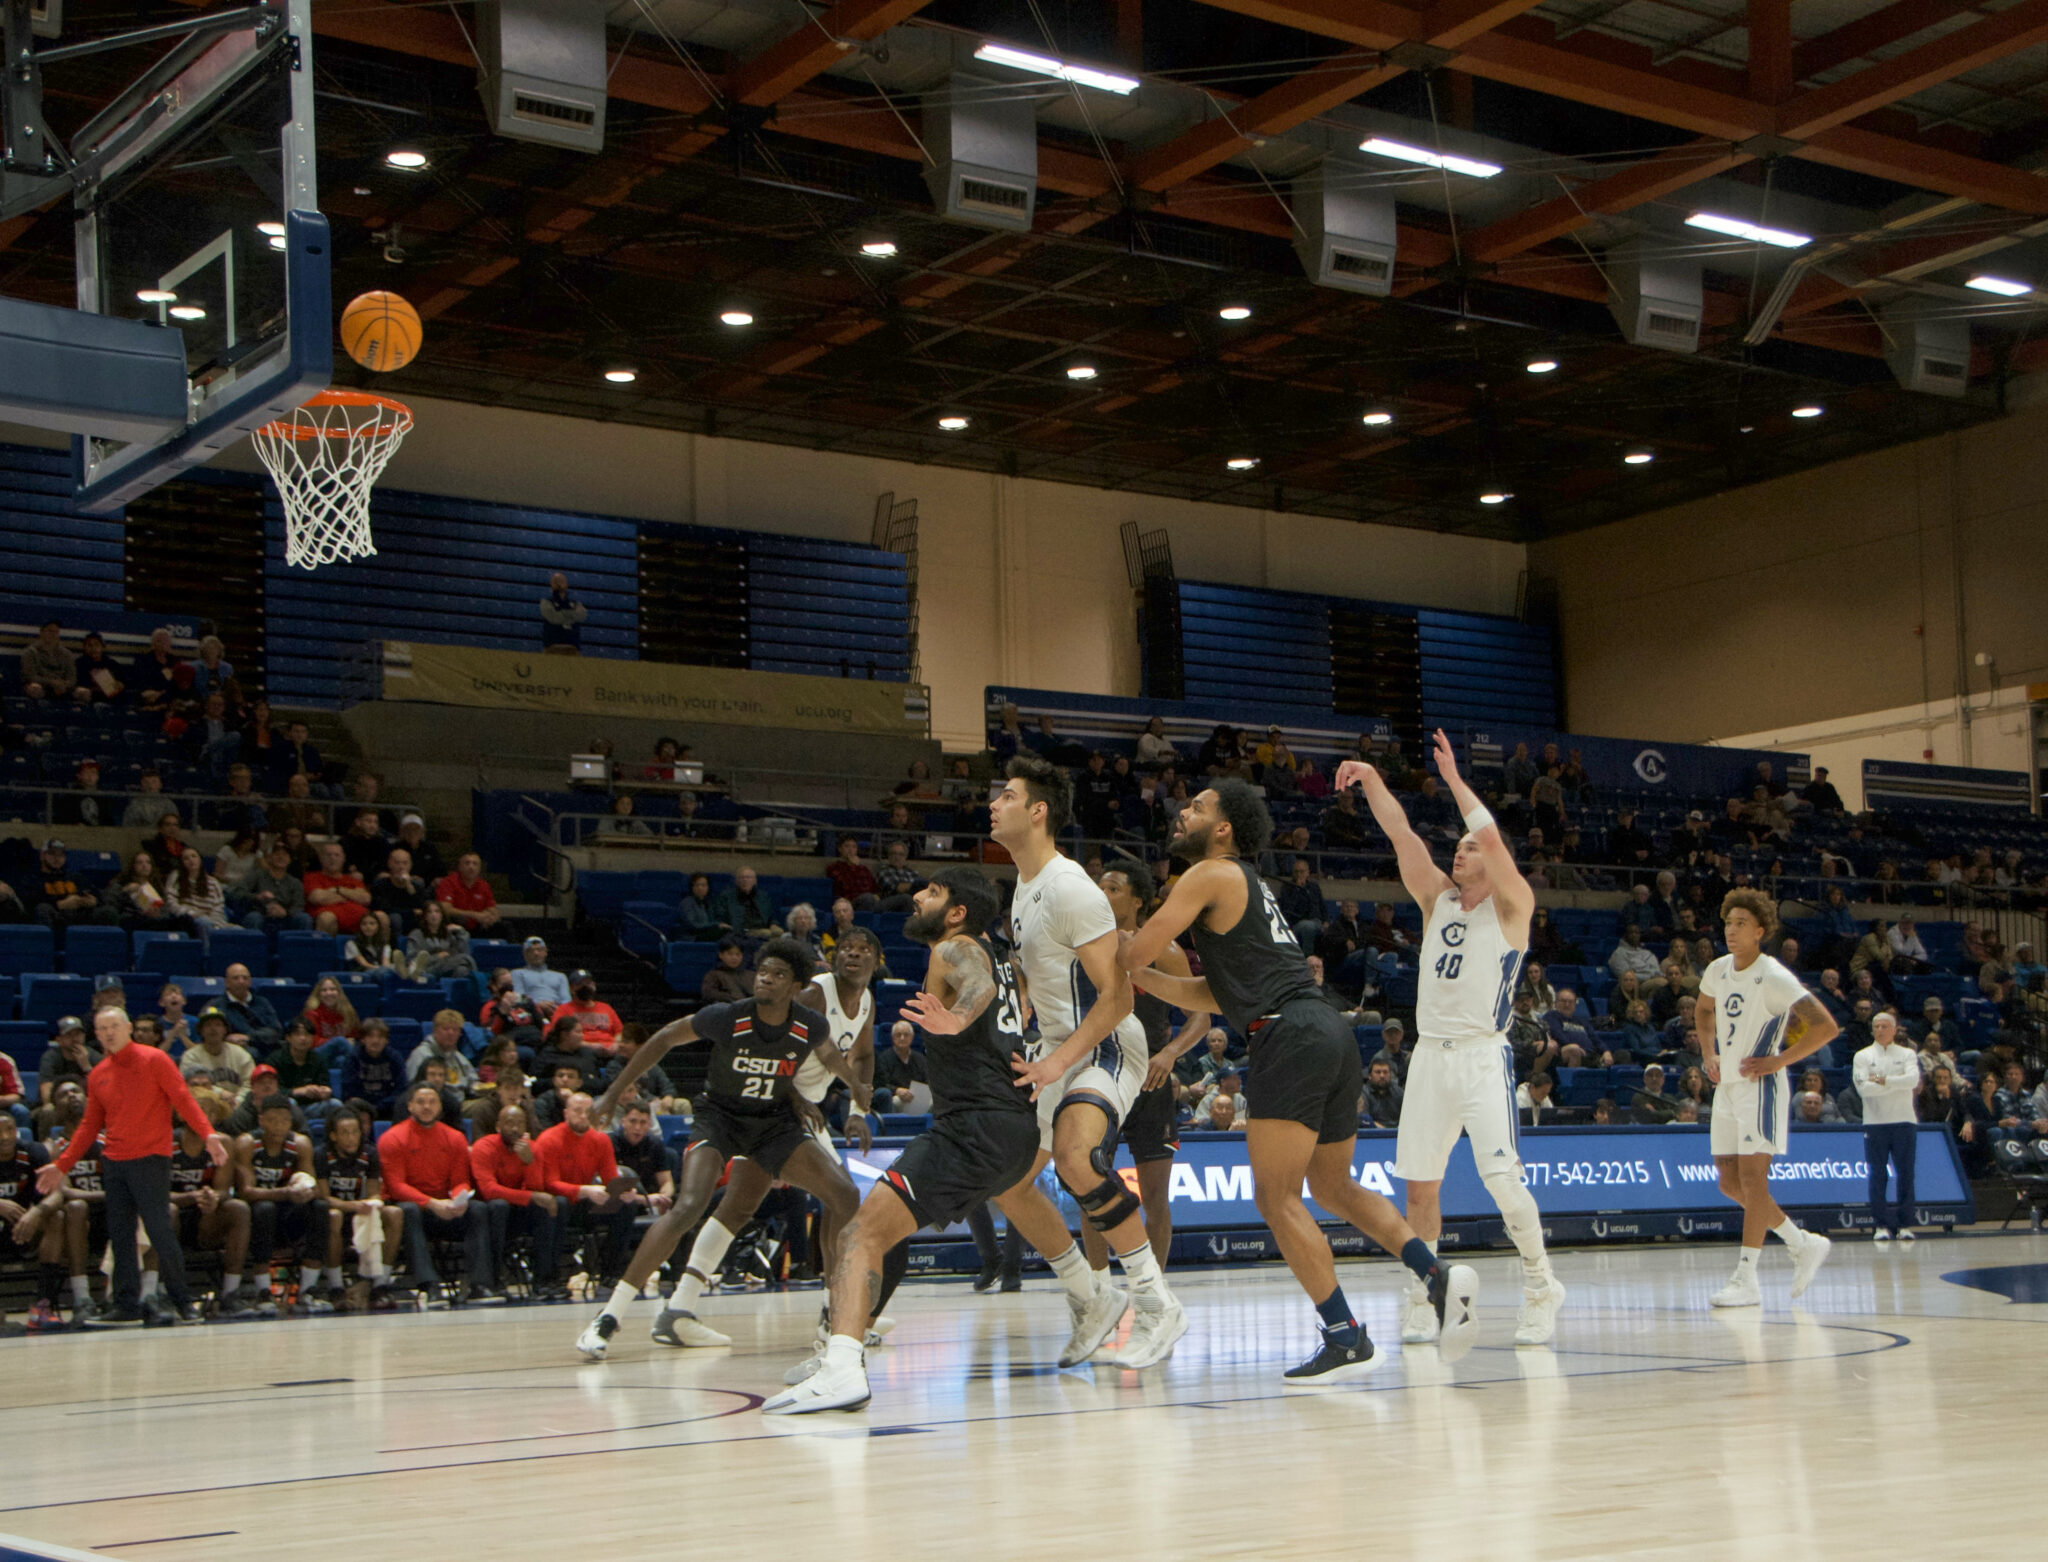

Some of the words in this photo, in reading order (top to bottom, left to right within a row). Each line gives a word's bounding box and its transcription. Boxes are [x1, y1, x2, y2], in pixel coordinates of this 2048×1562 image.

[472, 679, 573, 697] UNIVERSITY
[594, 687, 638, 704] Bank
[642, 692, 678, 707] with
[683, 696, 717, 711] your
[795, 704, 853, 722] ucu.org
[1435, 952, 1463, 980] 40
[732, 1055, 797, 1077] CSUN
[741, 1076, 775, 1100] 21
[1610, 1224, 1639, 1234] ucu.org
[1695, 1221, 1723, 1231] ucu.org
[1331, 1236, 1364, 1247] ucu.org
[1439, 1231, 1460, 1242] u.org
[1231, 1240, 1265, 1251] ucu.org
[908, 1254, 935, 1265] u.org
